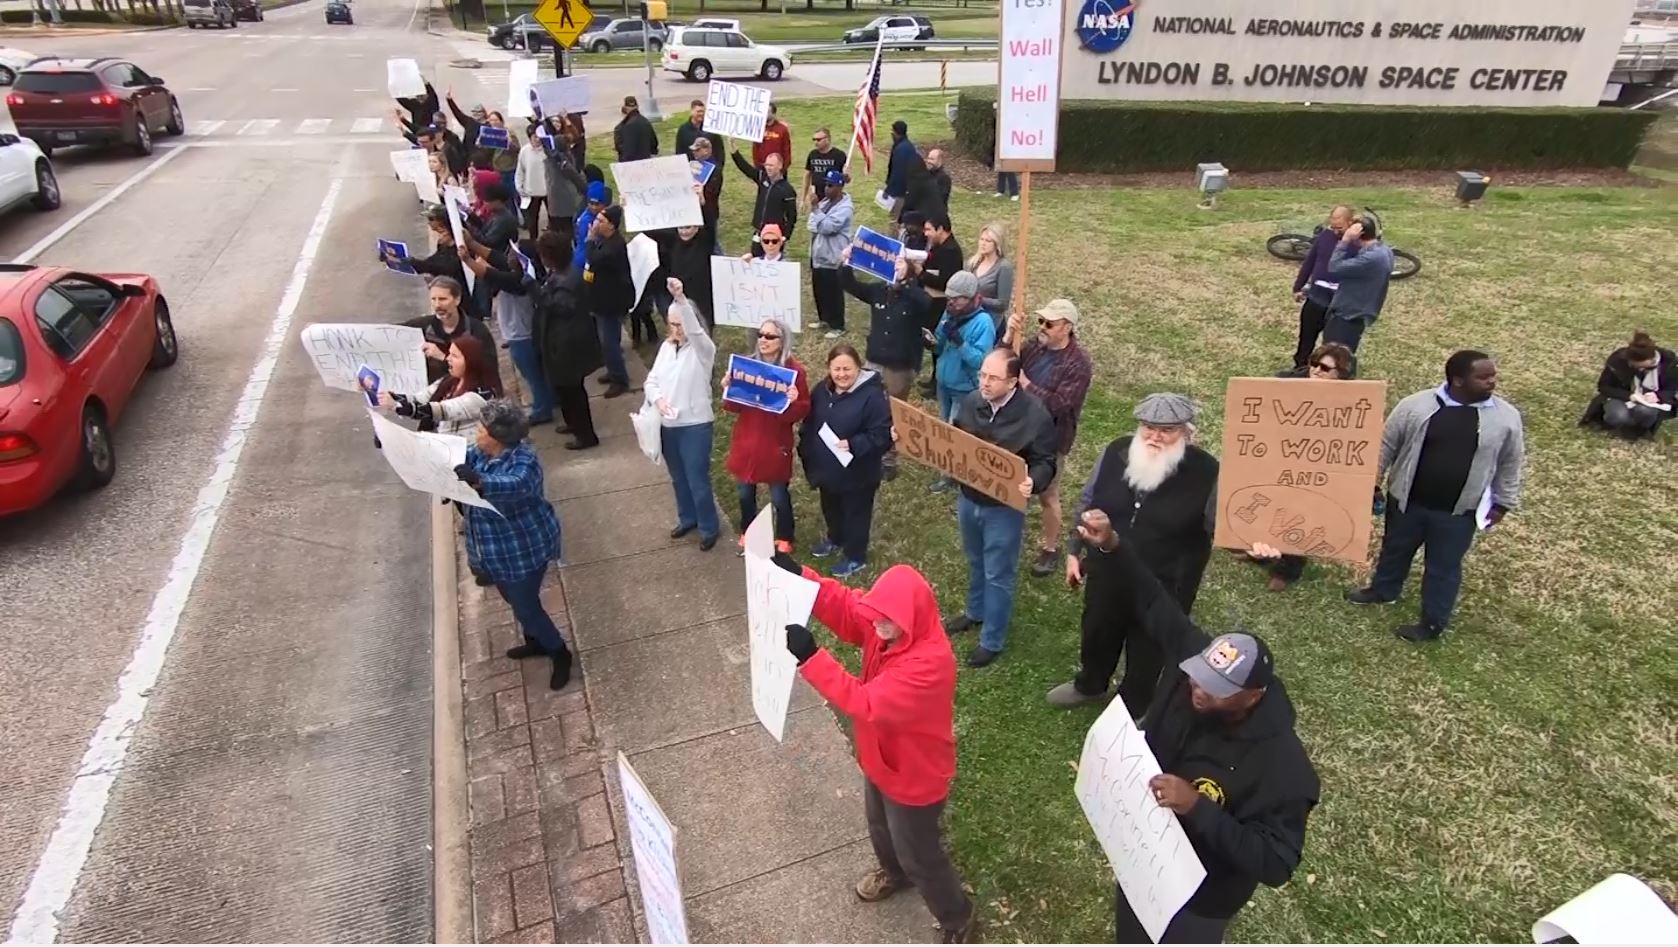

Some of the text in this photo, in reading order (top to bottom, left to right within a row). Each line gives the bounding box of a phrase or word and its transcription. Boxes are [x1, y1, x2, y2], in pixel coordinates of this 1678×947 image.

[1081, 14, 1131, 29] NASA
[1153, 16, 1585, 43] NATIONAL AERONAUTICS & SPACE ADMINISTRATION
[1009, 39, 1052, 57] Wall
[1098, 61, 1568, 91] LYNDON B. JOHNSON SPACE CENTER
[710, 82, 767, 113] END THE
[1011, 85, 1047, 102] Hell
[704, 108, 764, 139] SHUTDOWN
[1011, 129, 1043, 146] No!
[723, 258, 780, 278] THIS
[310, 328, 375, 350] HONK
[366, 349, 419, 371] THE
[733, 369, 744, 380] Let
[744, 373, 755, 384] me
[755, 375, 765, 387] do
[764, 379, 776, 392] my
[1241, 397, 1263, 423] I
[1281, 438, 1369, 466] WORK
[1277, 469, 1329, 486] AND
[1234, 492, 1272, 525] I
